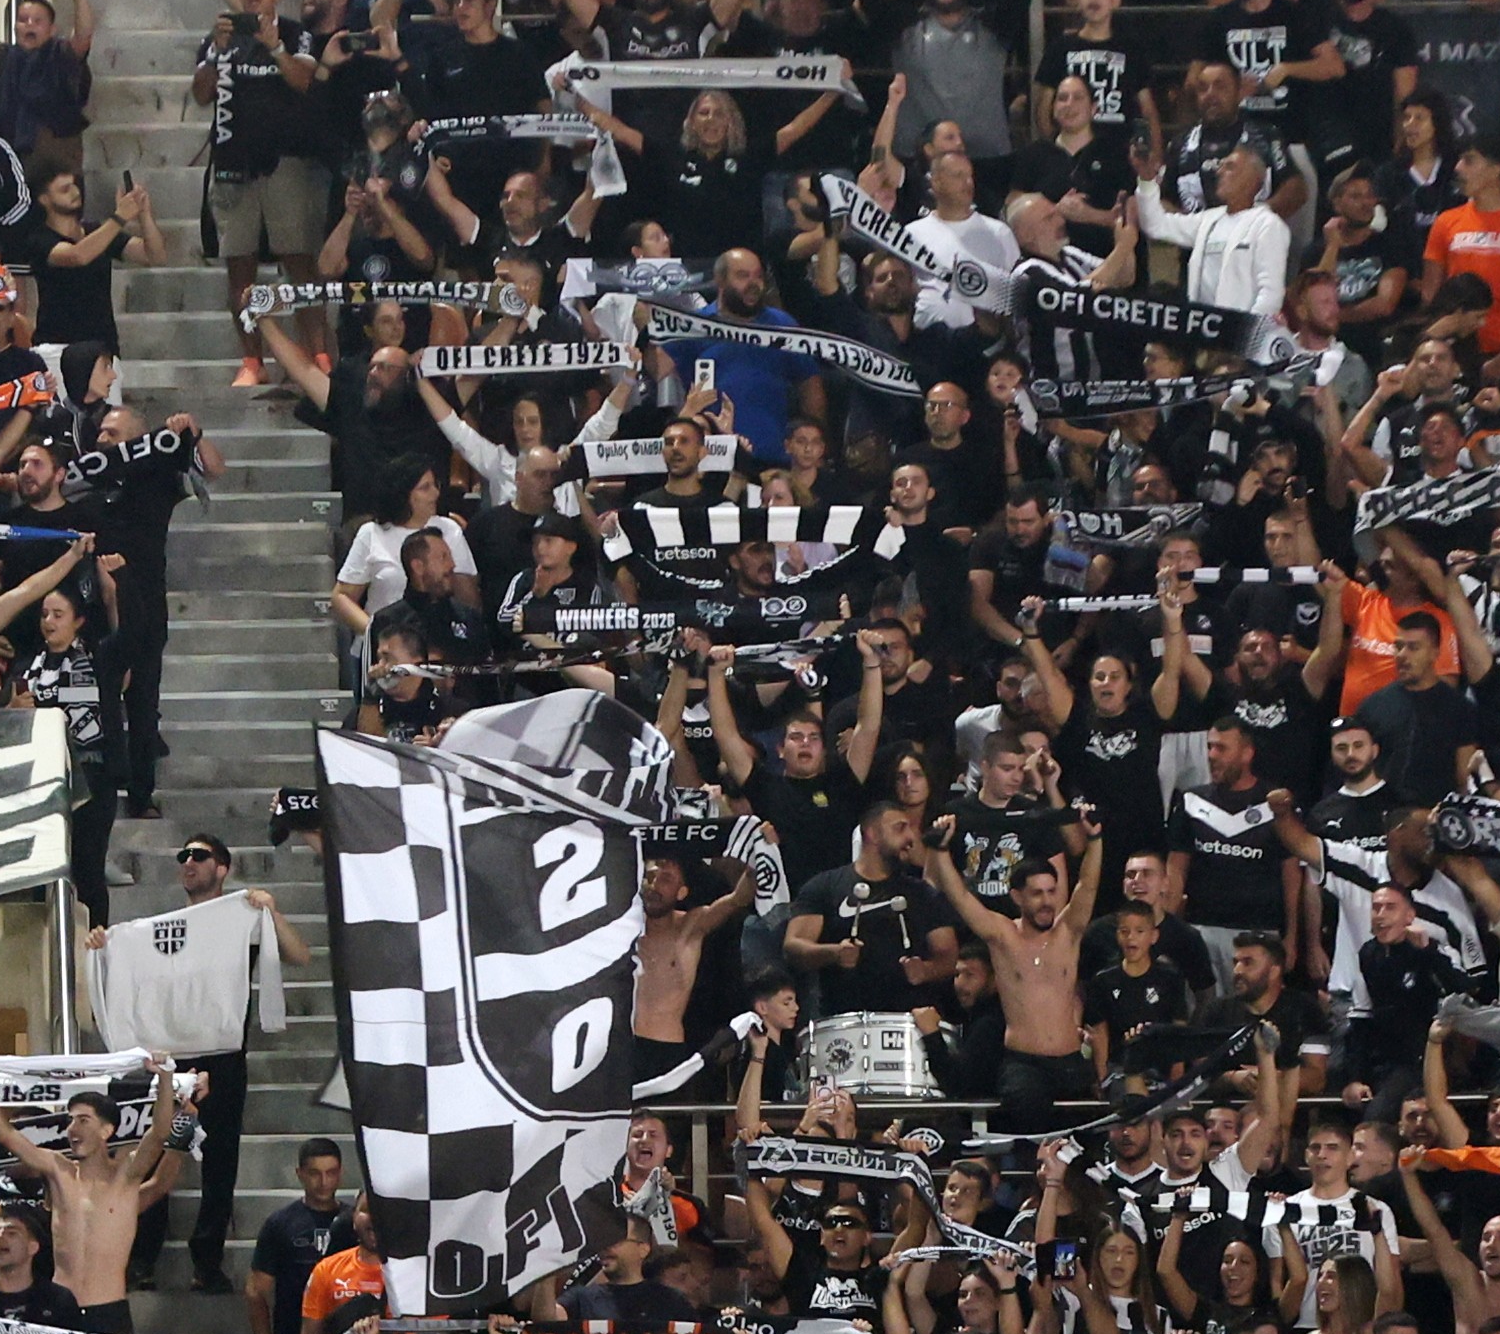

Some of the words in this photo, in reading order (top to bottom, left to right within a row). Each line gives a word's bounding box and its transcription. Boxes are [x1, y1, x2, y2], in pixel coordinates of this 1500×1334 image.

[1037, 288, 1084, 320] OFI
[1092, 293, 1181, 331] CRETE
[1185, 313, 1223, 338] FC
[654, 544, 718, 562] betsson
[555, 608, 638, 631] WINNERS
[677, 821, 719, 842] FC
[1195, 841, 1262, 861] betsson
[538, 818, 609, 932] 2
[552, 996, 612, 1094] 0
